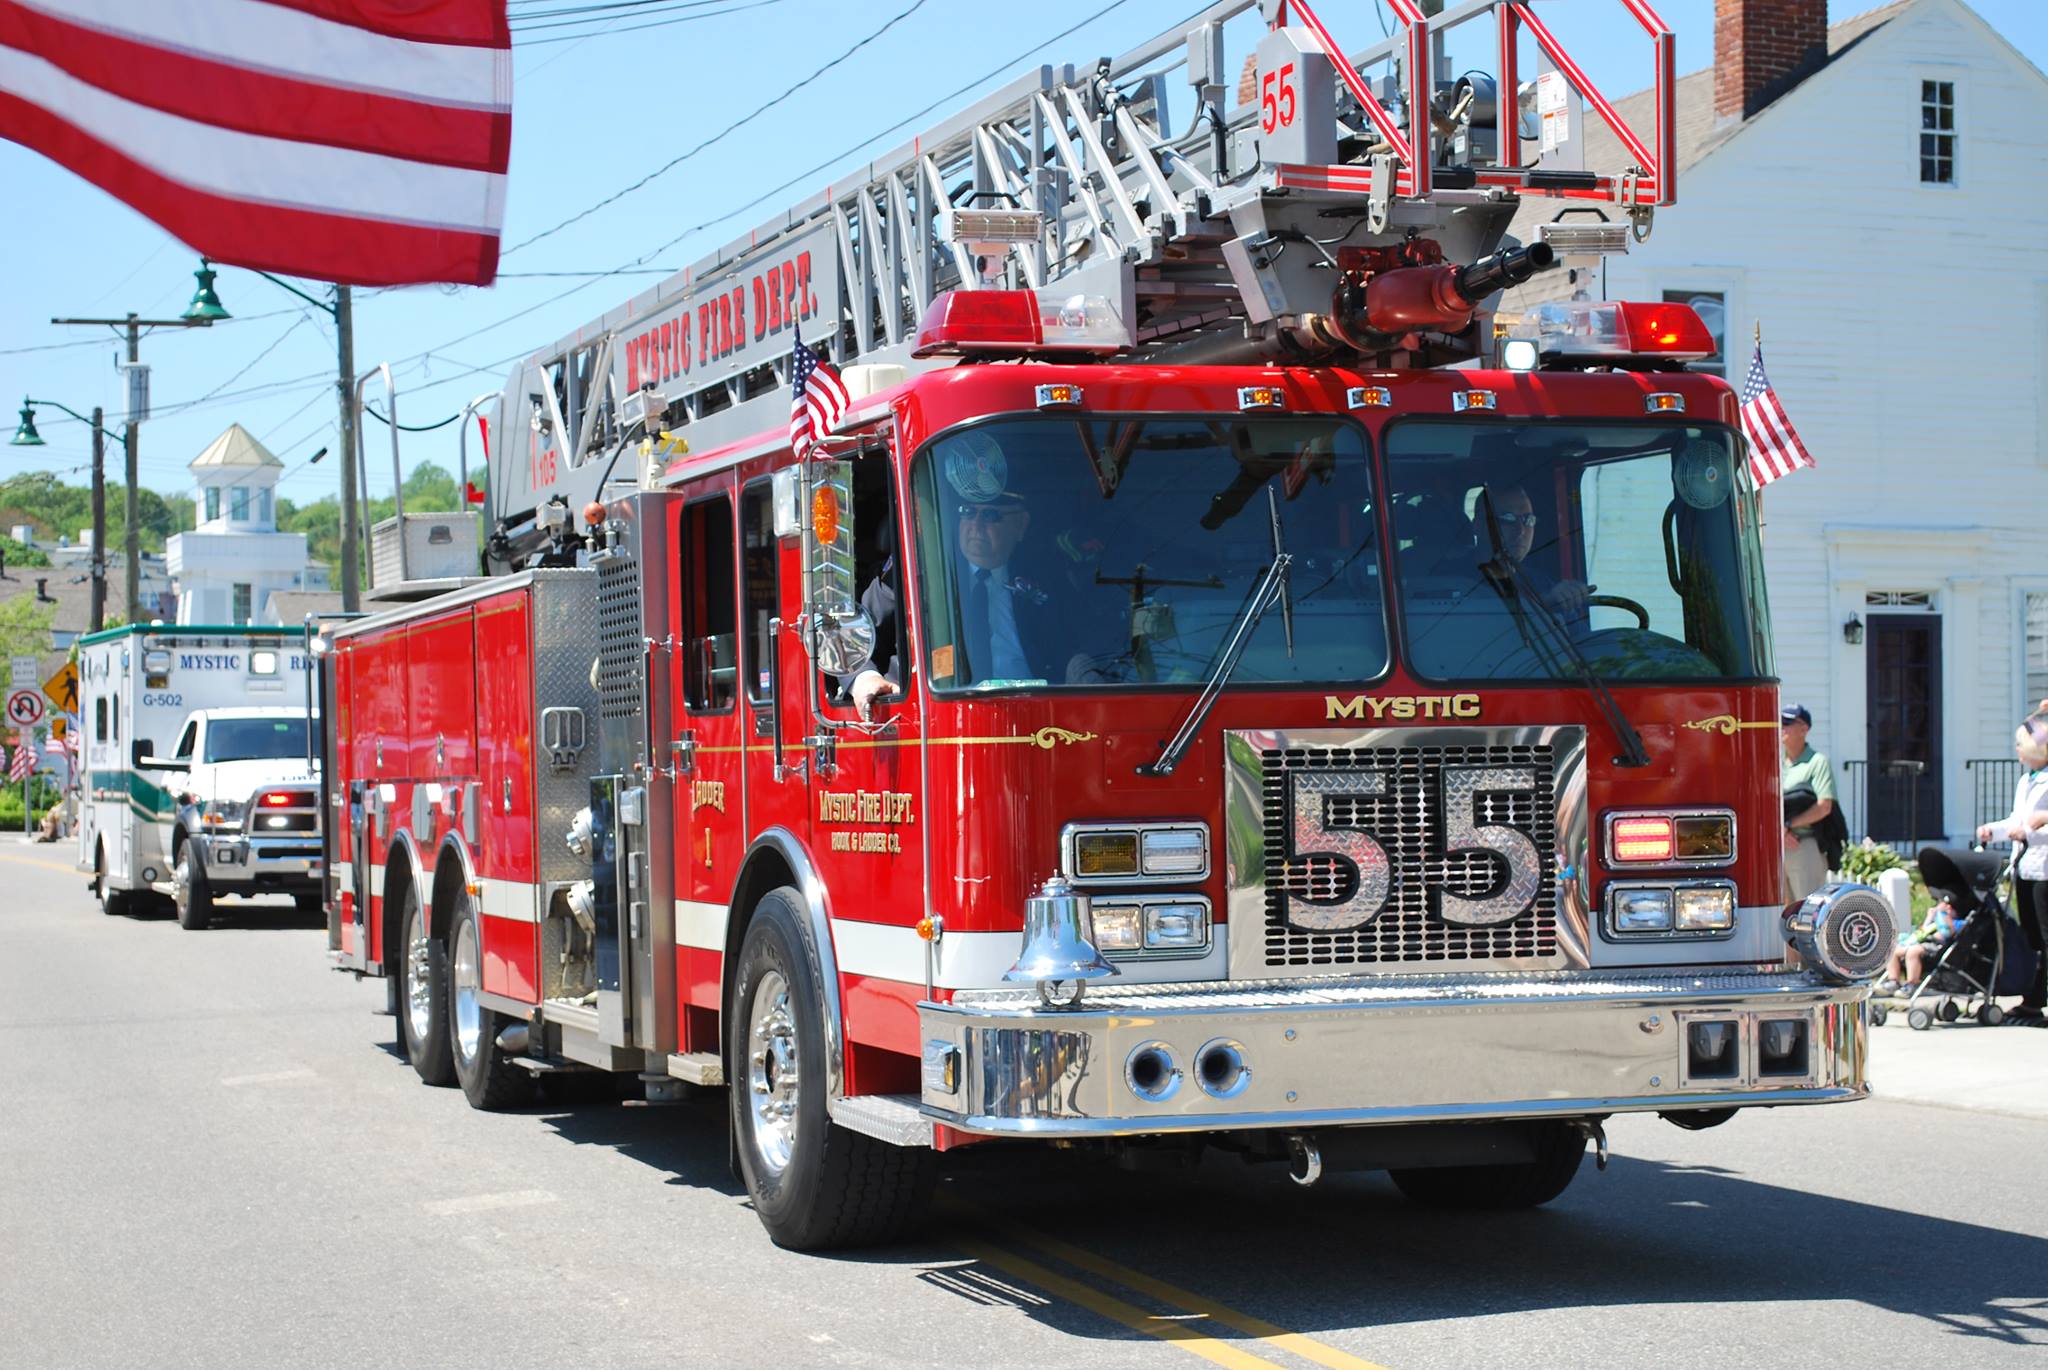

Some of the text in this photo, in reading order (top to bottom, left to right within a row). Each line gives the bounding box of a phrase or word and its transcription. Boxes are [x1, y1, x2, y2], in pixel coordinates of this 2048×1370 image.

[1263, 63, 1295, 134] 55
[625, 250, 818, 395] MYSTIC FIRE DEPT.
[539, 450, 556, 487] 105
[180, 654, 240, 670] MYSTIC
[143, 693, 183, 706] G-502
[1325, 693, 1481, 720] MYSTIC
[691, 780, 725, 814] LADDER
[819, 789, 915, 824] MYSTIC FIRE DEPT.
[831, 832, 902, 853] HOOK & LADDER CO.
[1285, 765, 1544, 933] 55
